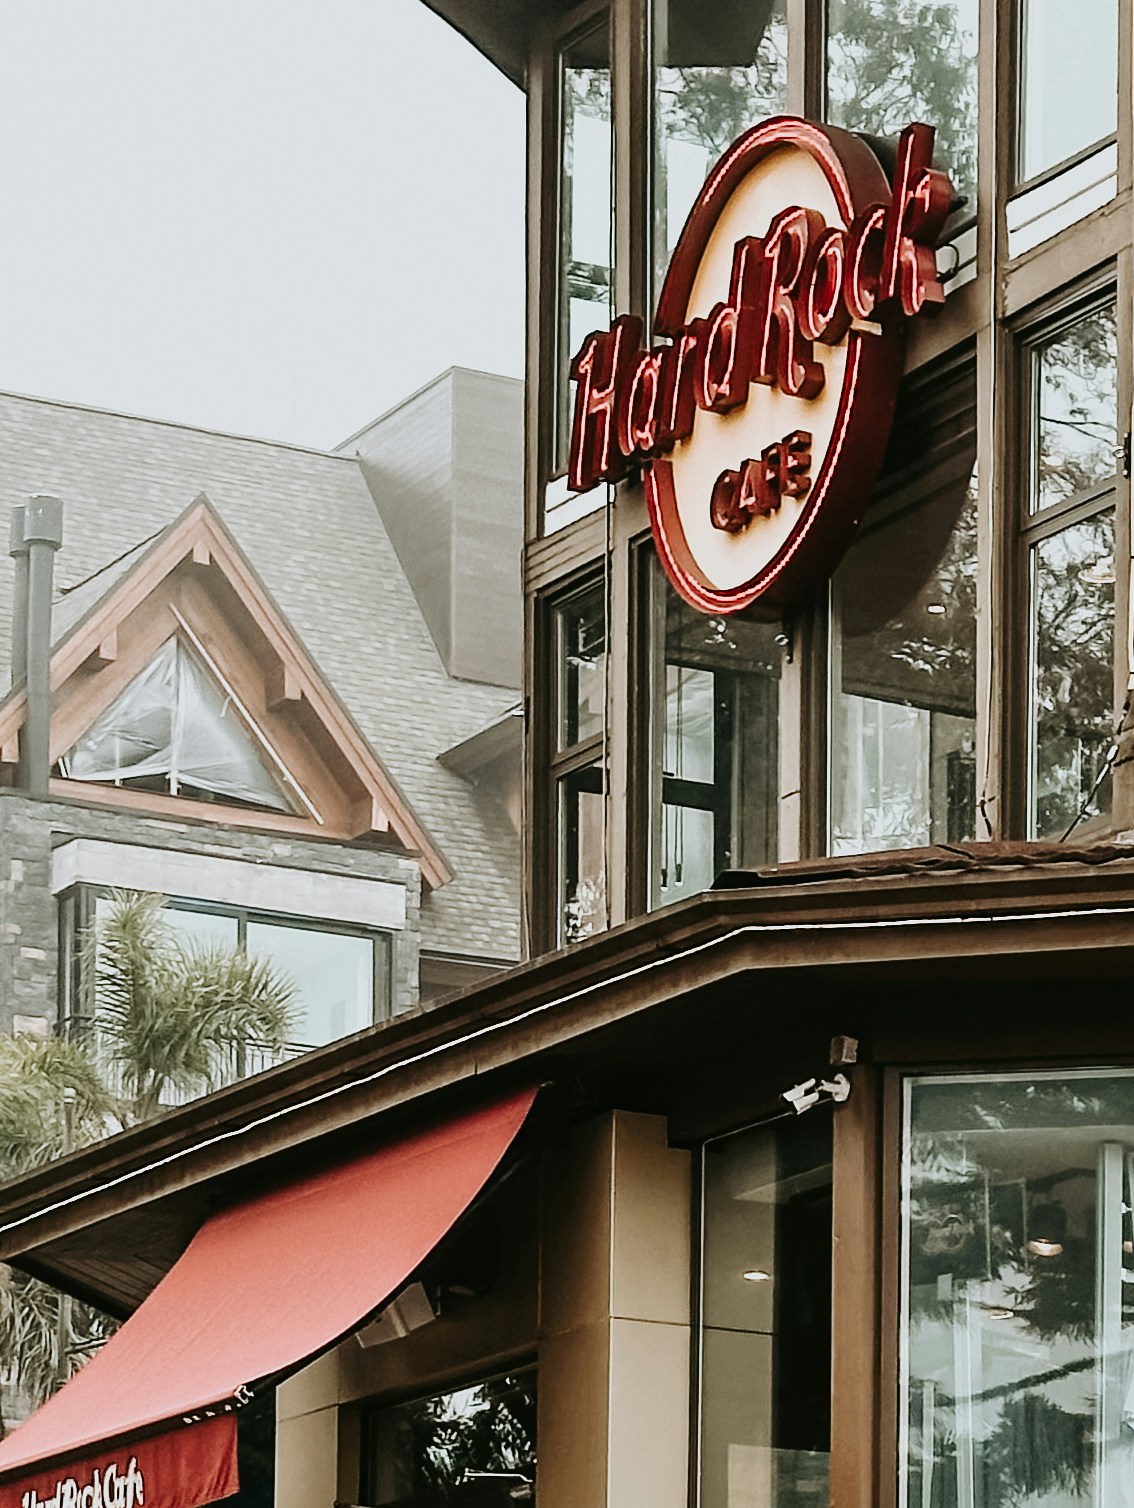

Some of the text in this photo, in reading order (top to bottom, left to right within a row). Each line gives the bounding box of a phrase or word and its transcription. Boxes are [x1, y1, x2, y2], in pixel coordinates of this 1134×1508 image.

[568, 122, 953, 491] Hard Rock
[711, 430, 812, 532] CAFE
